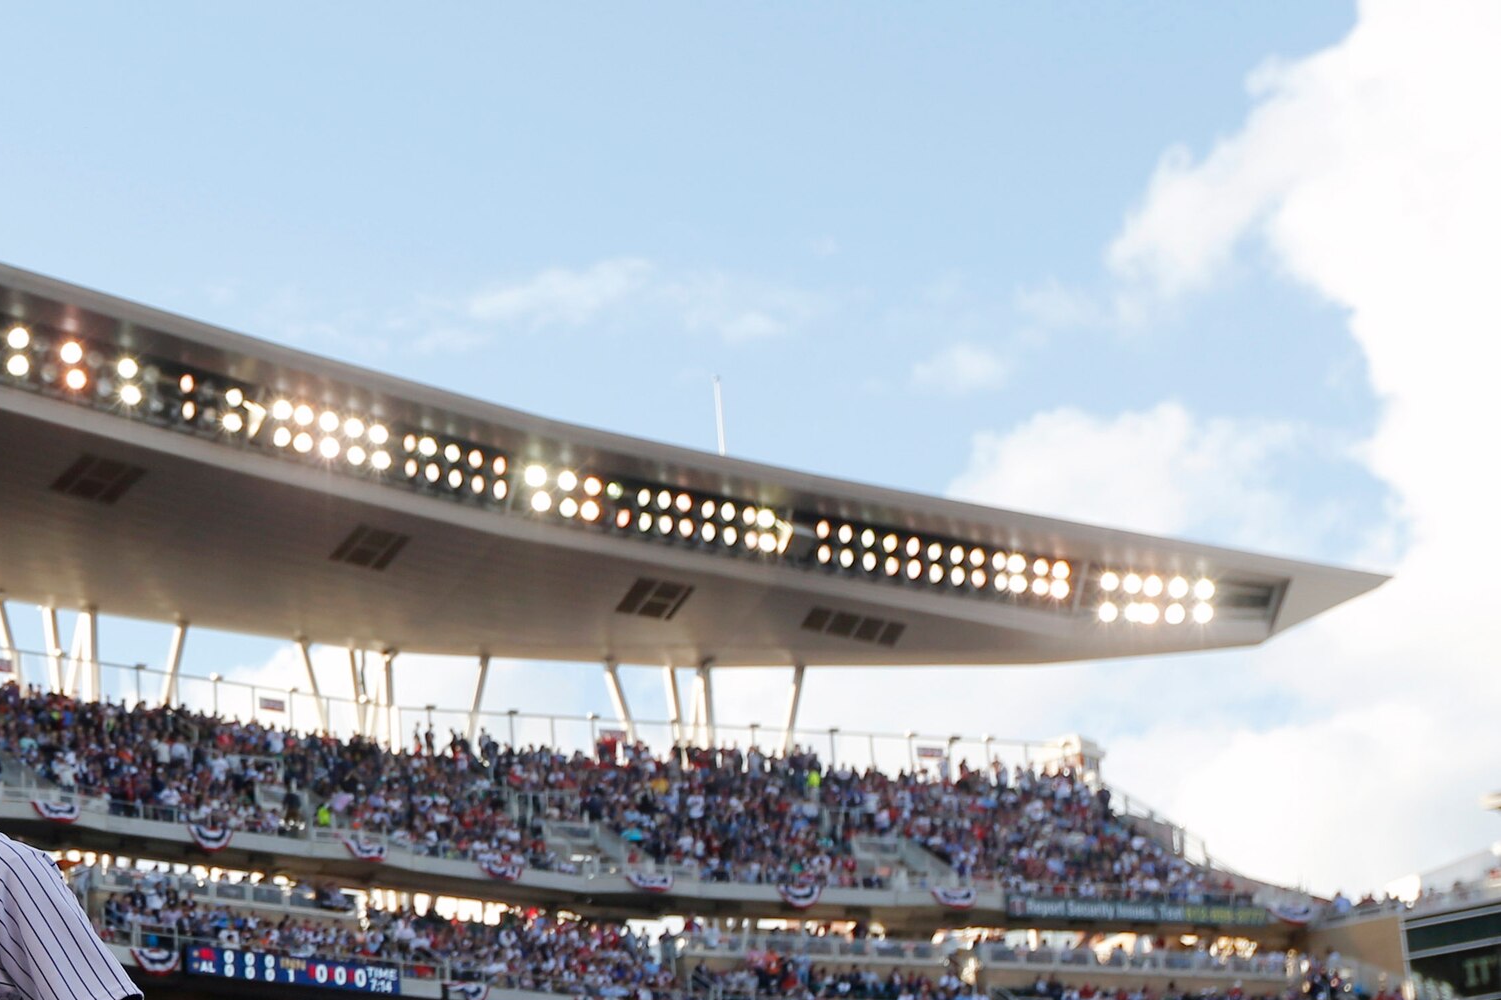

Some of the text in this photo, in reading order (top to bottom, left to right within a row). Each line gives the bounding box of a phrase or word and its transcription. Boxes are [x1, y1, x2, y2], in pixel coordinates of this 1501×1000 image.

[200, 960, 216, 973] AL
[287, 969, 295, 982] 1
[316, 964, 328, 983] 0
[334, 966, 347, 985] 0
[354, 968, 367, 988] 0
[366, 966, 398, 981] TIME
[369, 979, 393, 993] 7:14
